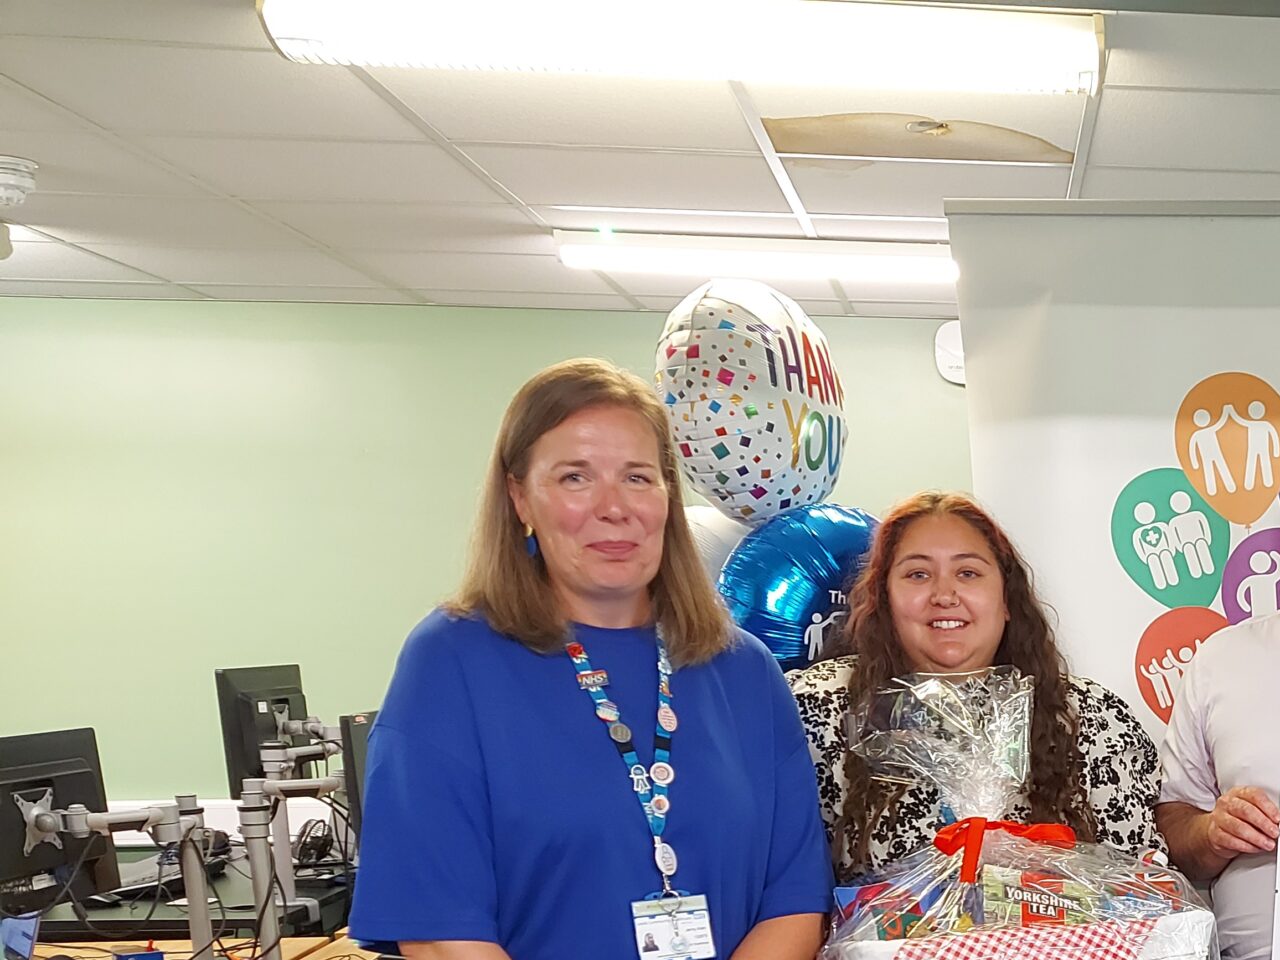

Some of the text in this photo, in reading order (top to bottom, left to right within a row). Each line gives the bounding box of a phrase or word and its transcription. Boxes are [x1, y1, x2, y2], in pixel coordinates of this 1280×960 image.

[782, 399, 841, 476] YOU
[828, 590, 847, 605] Th
[582, 675, 604, 685] NHS
[1006, 886, 1080, 911] YORKSHIRE
[1031, 902, 1056, 917] TEA
